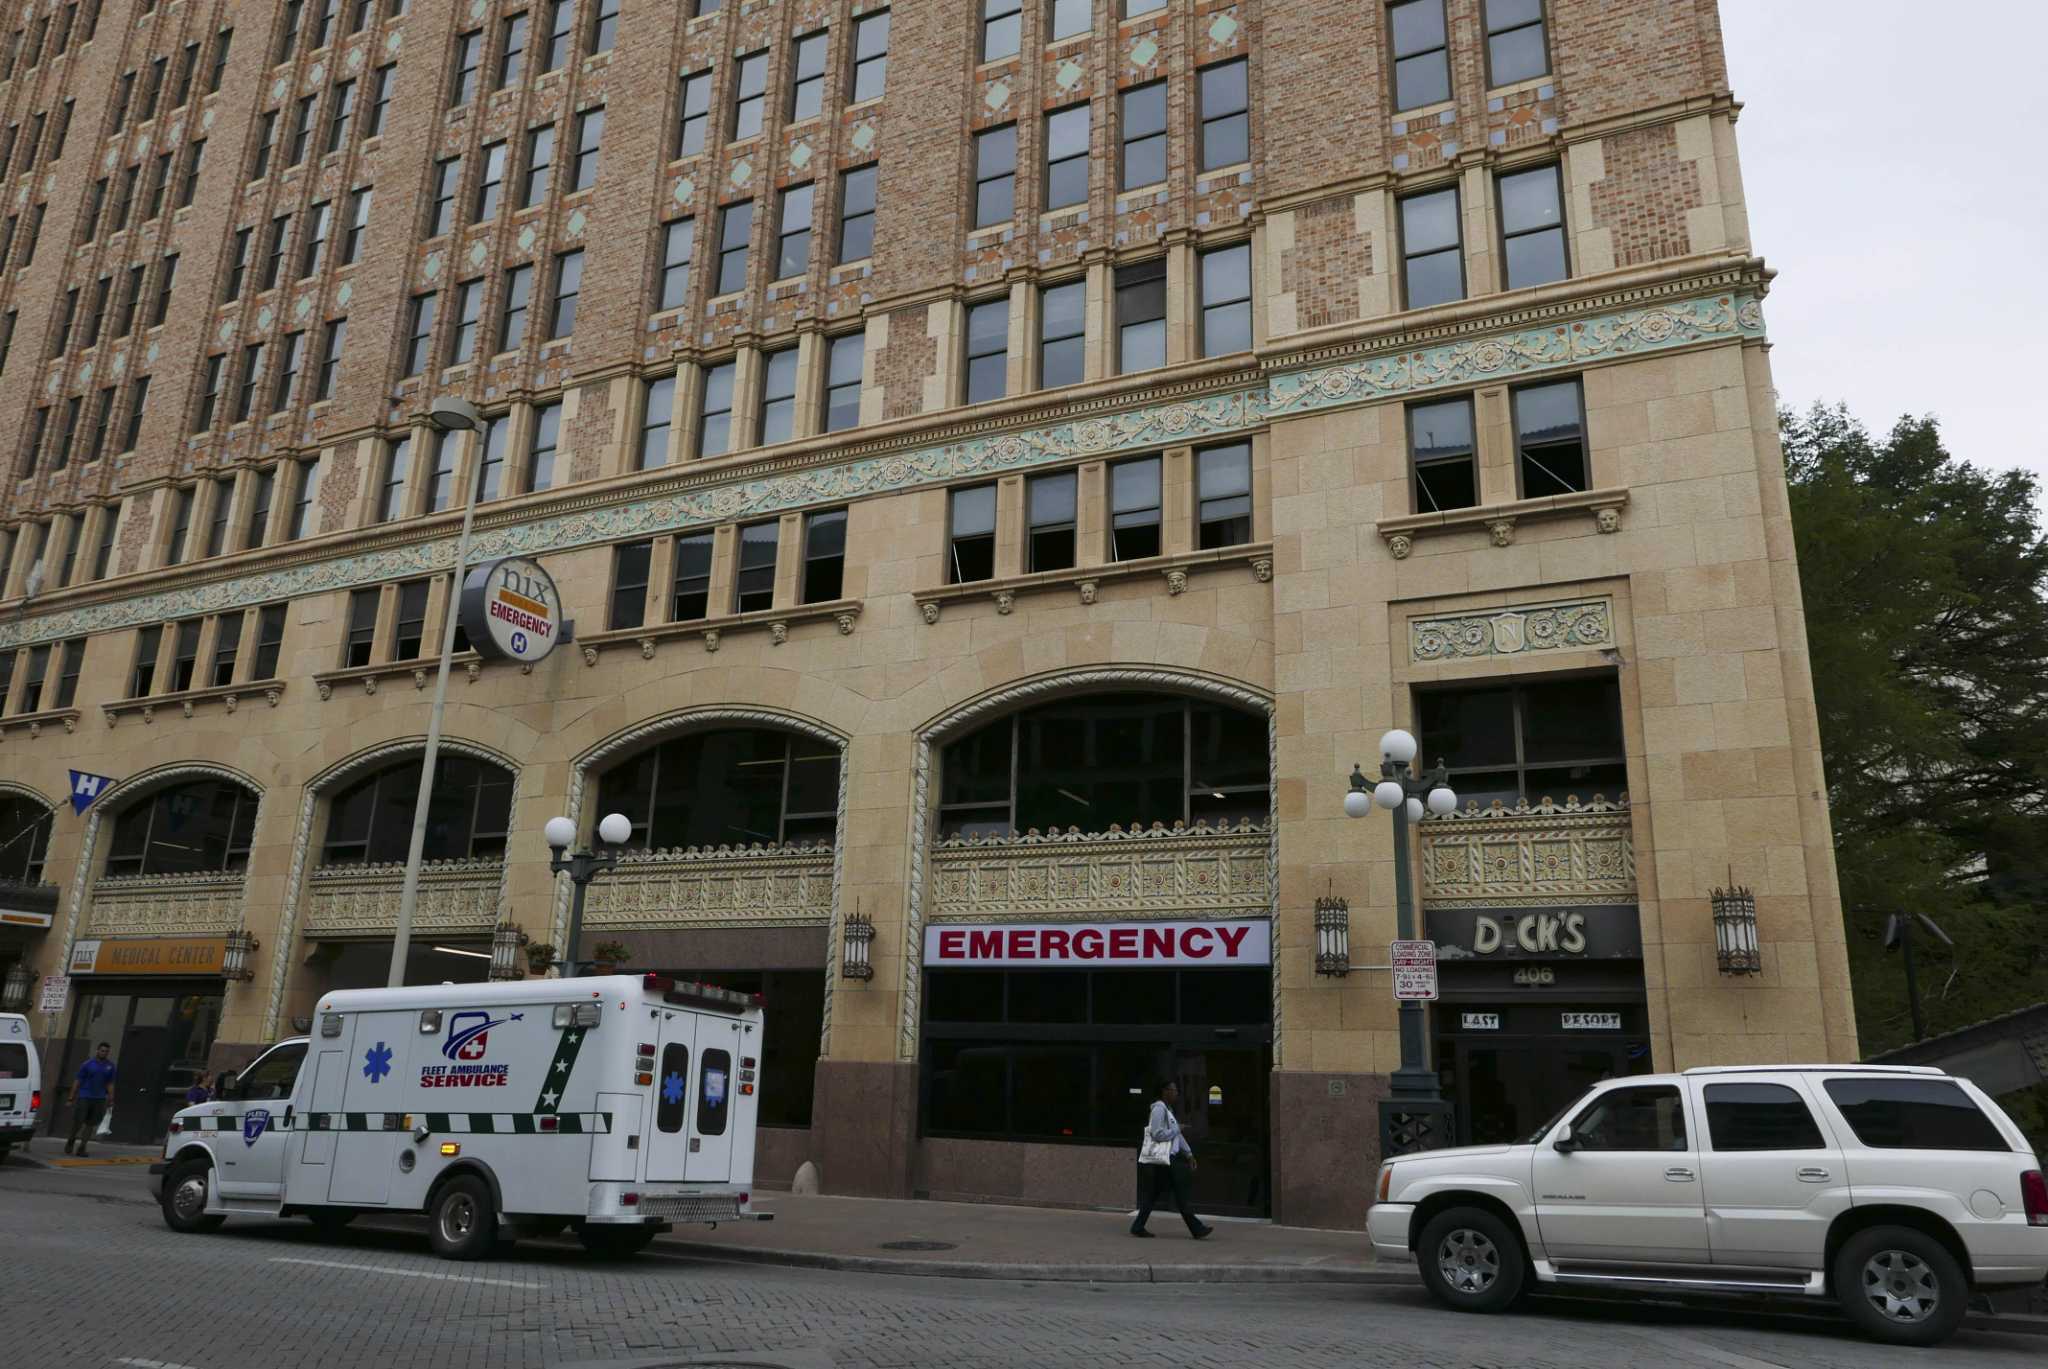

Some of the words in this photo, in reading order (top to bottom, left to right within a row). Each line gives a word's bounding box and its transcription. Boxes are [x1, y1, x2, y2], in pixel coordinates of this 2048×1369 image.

[500, 565, 550, 606] nix
[490, 600, 552, 639] EMERGENCY
[1500, 622, 1519, 645] N
[75, 774, 100, 797] H
[1474, 911, 1586, 954] DCK'S
[75, 944, 95, 962] nix
[111, 946, 161, 964] MEDICAL
[168, 944, 216, 964] CENTER
[939, 927, 1251, 960] EMERGENCY
[1514, 967, 1554, 983] 406
[1463, 1014, 1498, 1026] LAST
[1563, 1014, 1619, 1026] RESORT
[421, 1065, 447, 1075] FLEET
[450, 1064, 509, 1075] AMBULANCE
[420, 1074, 507, 1088] SERVICE
[247, 1111, 268, 1119] FLEET
